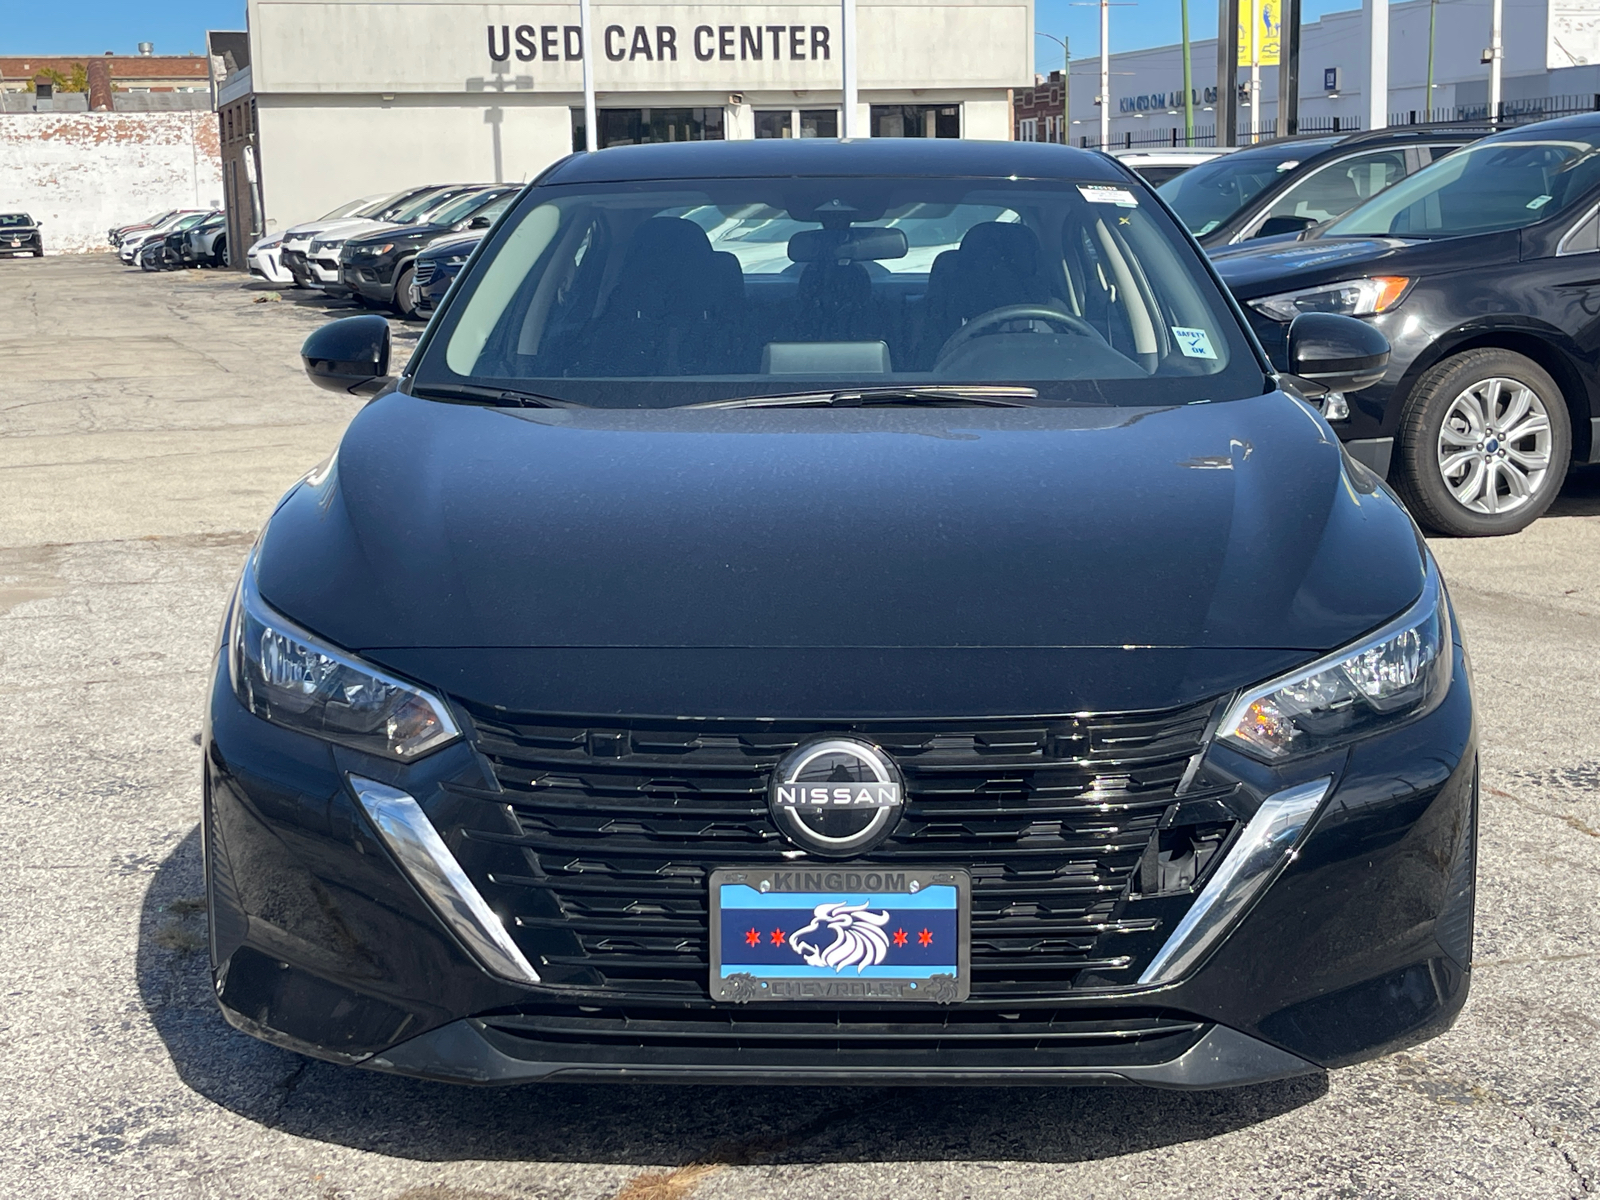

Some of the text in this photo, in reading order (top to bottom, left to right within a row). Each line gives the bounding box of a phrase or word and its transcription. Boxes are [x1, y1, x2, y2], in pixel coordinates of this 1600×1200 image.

[487, 25, 831, 61] USED CAR CENTER
[1119, 93, 1166, 112] KINGDOM
[1168, 89, 1201, 108] AUO
[1176, 330, 1205, 338] SAFETY
[777, 786, 897, 805] NISSAN
[774, 872, 906, 892] KINGDOM
[771, 981, 908, 997] CHEVROLET
